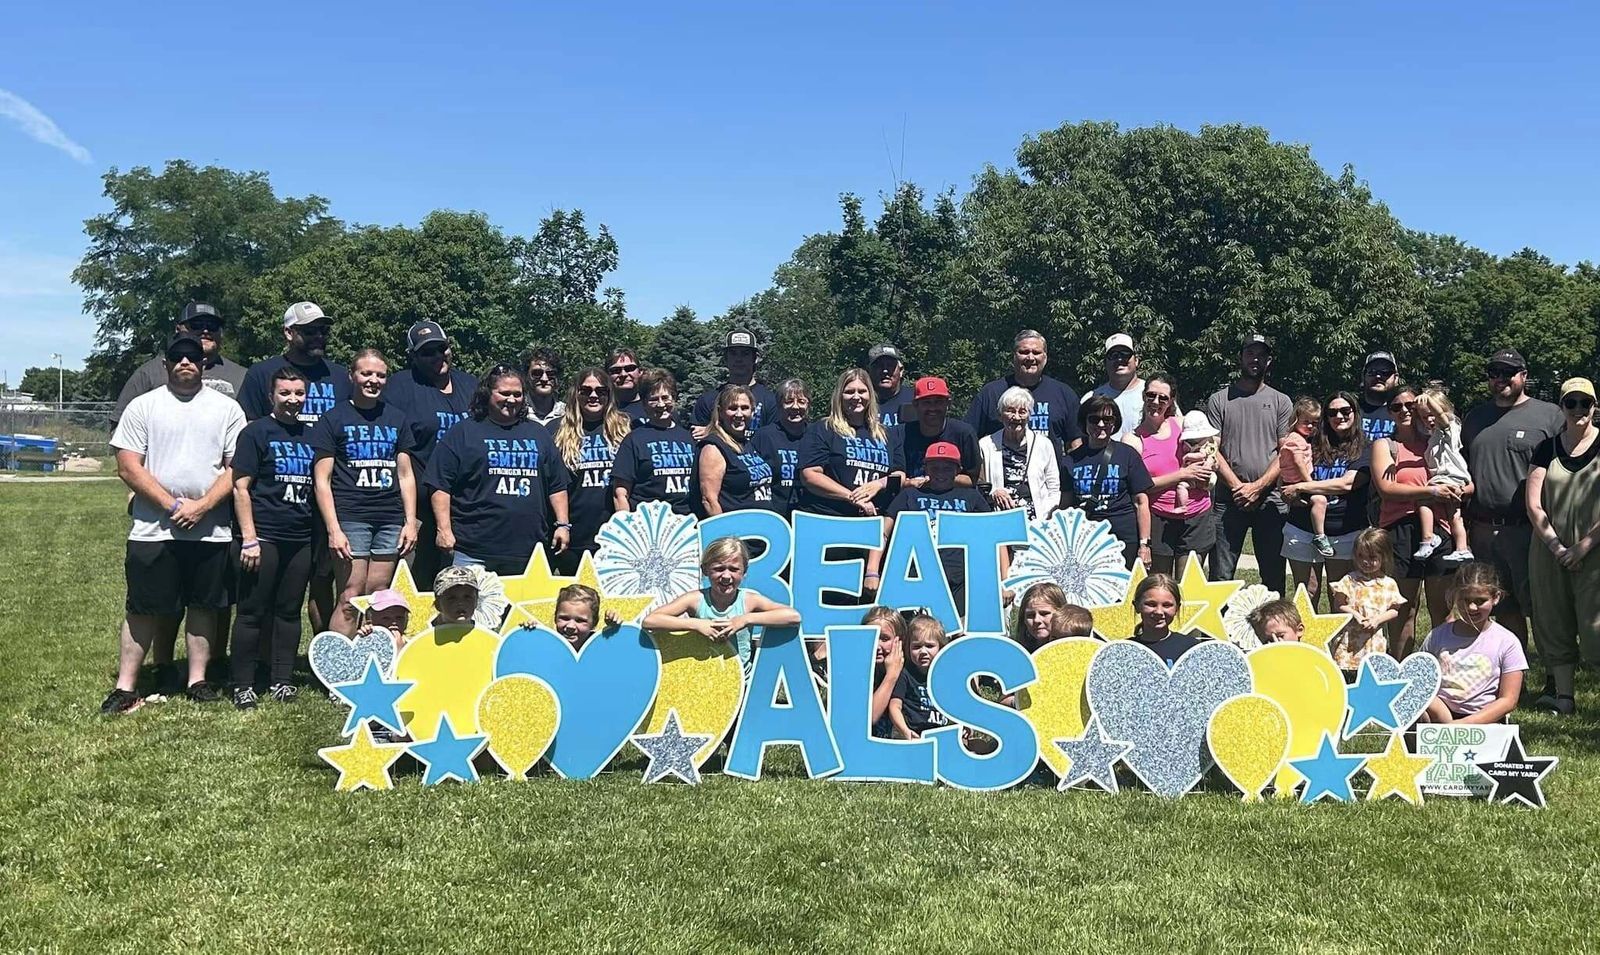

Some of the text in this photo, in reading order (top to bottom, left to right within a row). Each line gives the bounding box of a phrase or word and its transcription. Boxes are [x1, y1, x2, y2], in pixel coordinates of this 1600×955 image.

[307, 382, 335, 399] AM
[927, 381, 936, 391] C
[303, 399, 336, 414] ITH
[1362, 418, 1396, 433] EAM
[344, 426, 397, 443] TEAM
[484, 439, 538, 451] TEAM
[938, 447, 946, 455] C
[487, 451, 539, 469] SMITH
[778, 450, 798, 464] TE
[846, 447, 890, 466] SMITH
[275, 457, 314, 475] SMIT
[488, 467, 522, 476] STRONGER
[1073, 464, 1120, 480] TEM
[356, 468, 394, 489] ALS
[495, 477, 531, 497] ALS
[283, 484, 308, 504] AL
[917, 497, 967, 512] TEAM
[698, 508, 1028, 640] BEAT
[724, 626, 1037, 791] ALS
[1420, 727, 1486, 745] CARD
[1420, 746, 1459, 763] MY
